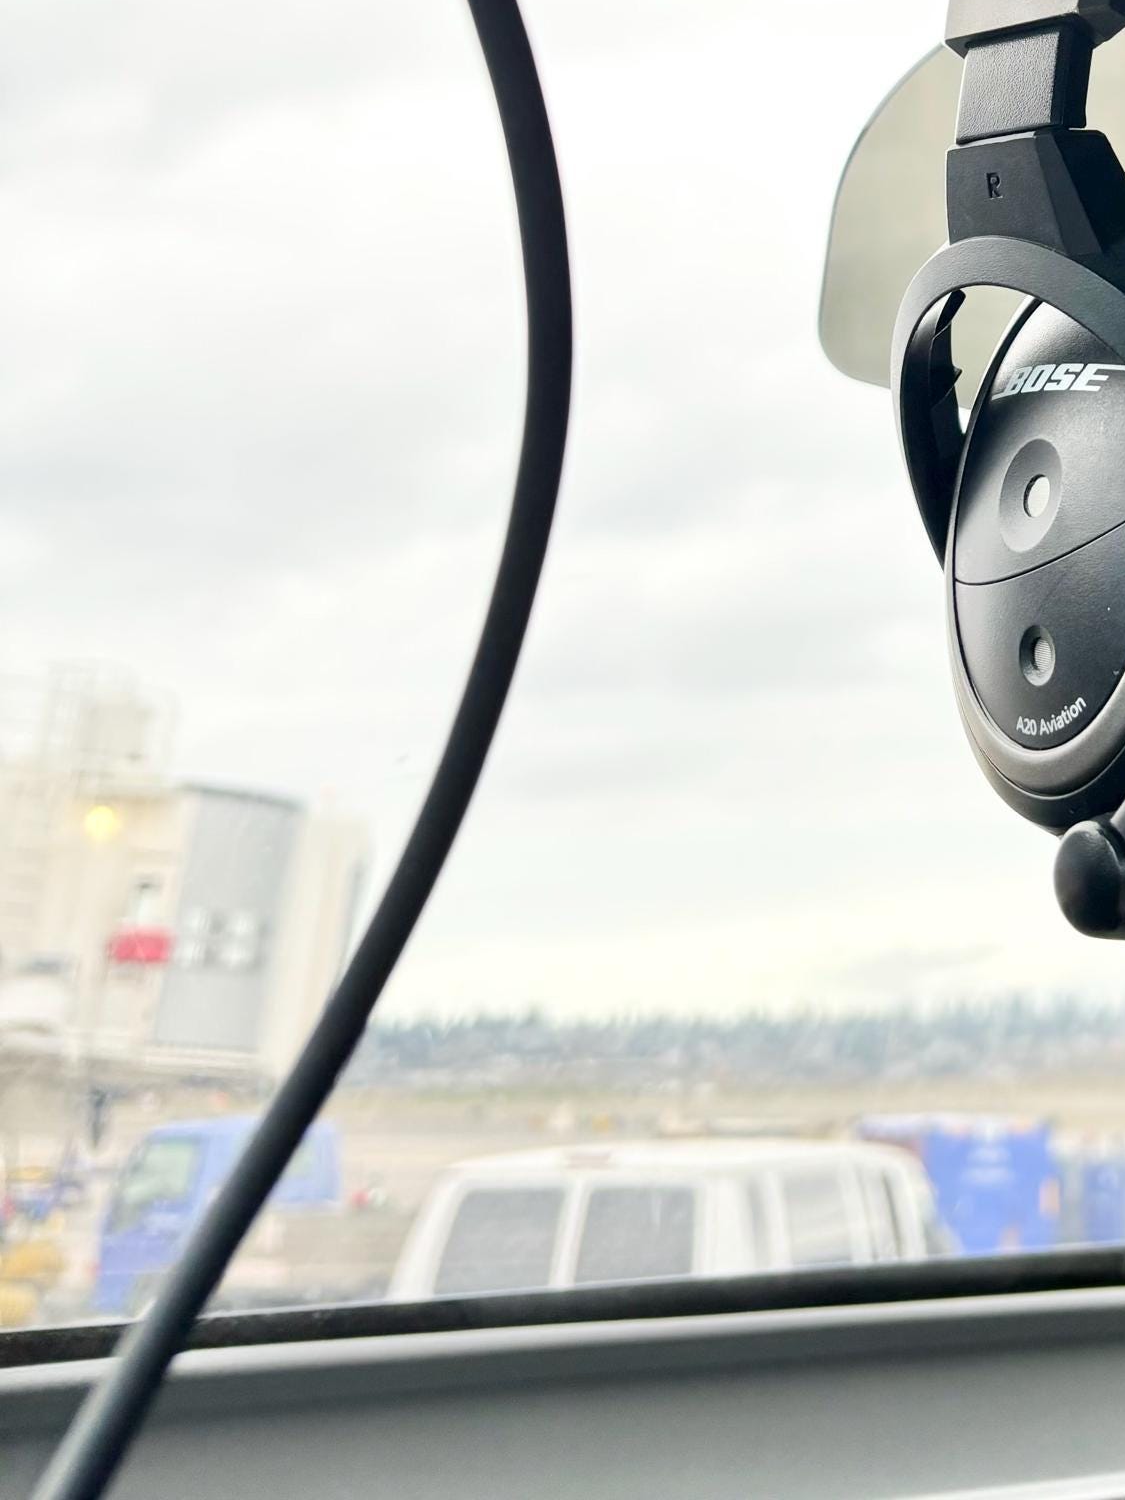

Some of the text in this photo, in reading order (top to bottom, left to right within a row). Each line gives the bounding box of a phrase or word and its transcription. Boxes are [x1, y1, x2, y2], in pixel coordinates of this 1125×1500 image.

[986, 172, 1003, 199] R
[1016, 697, 1087, 736] A20 Aviation
